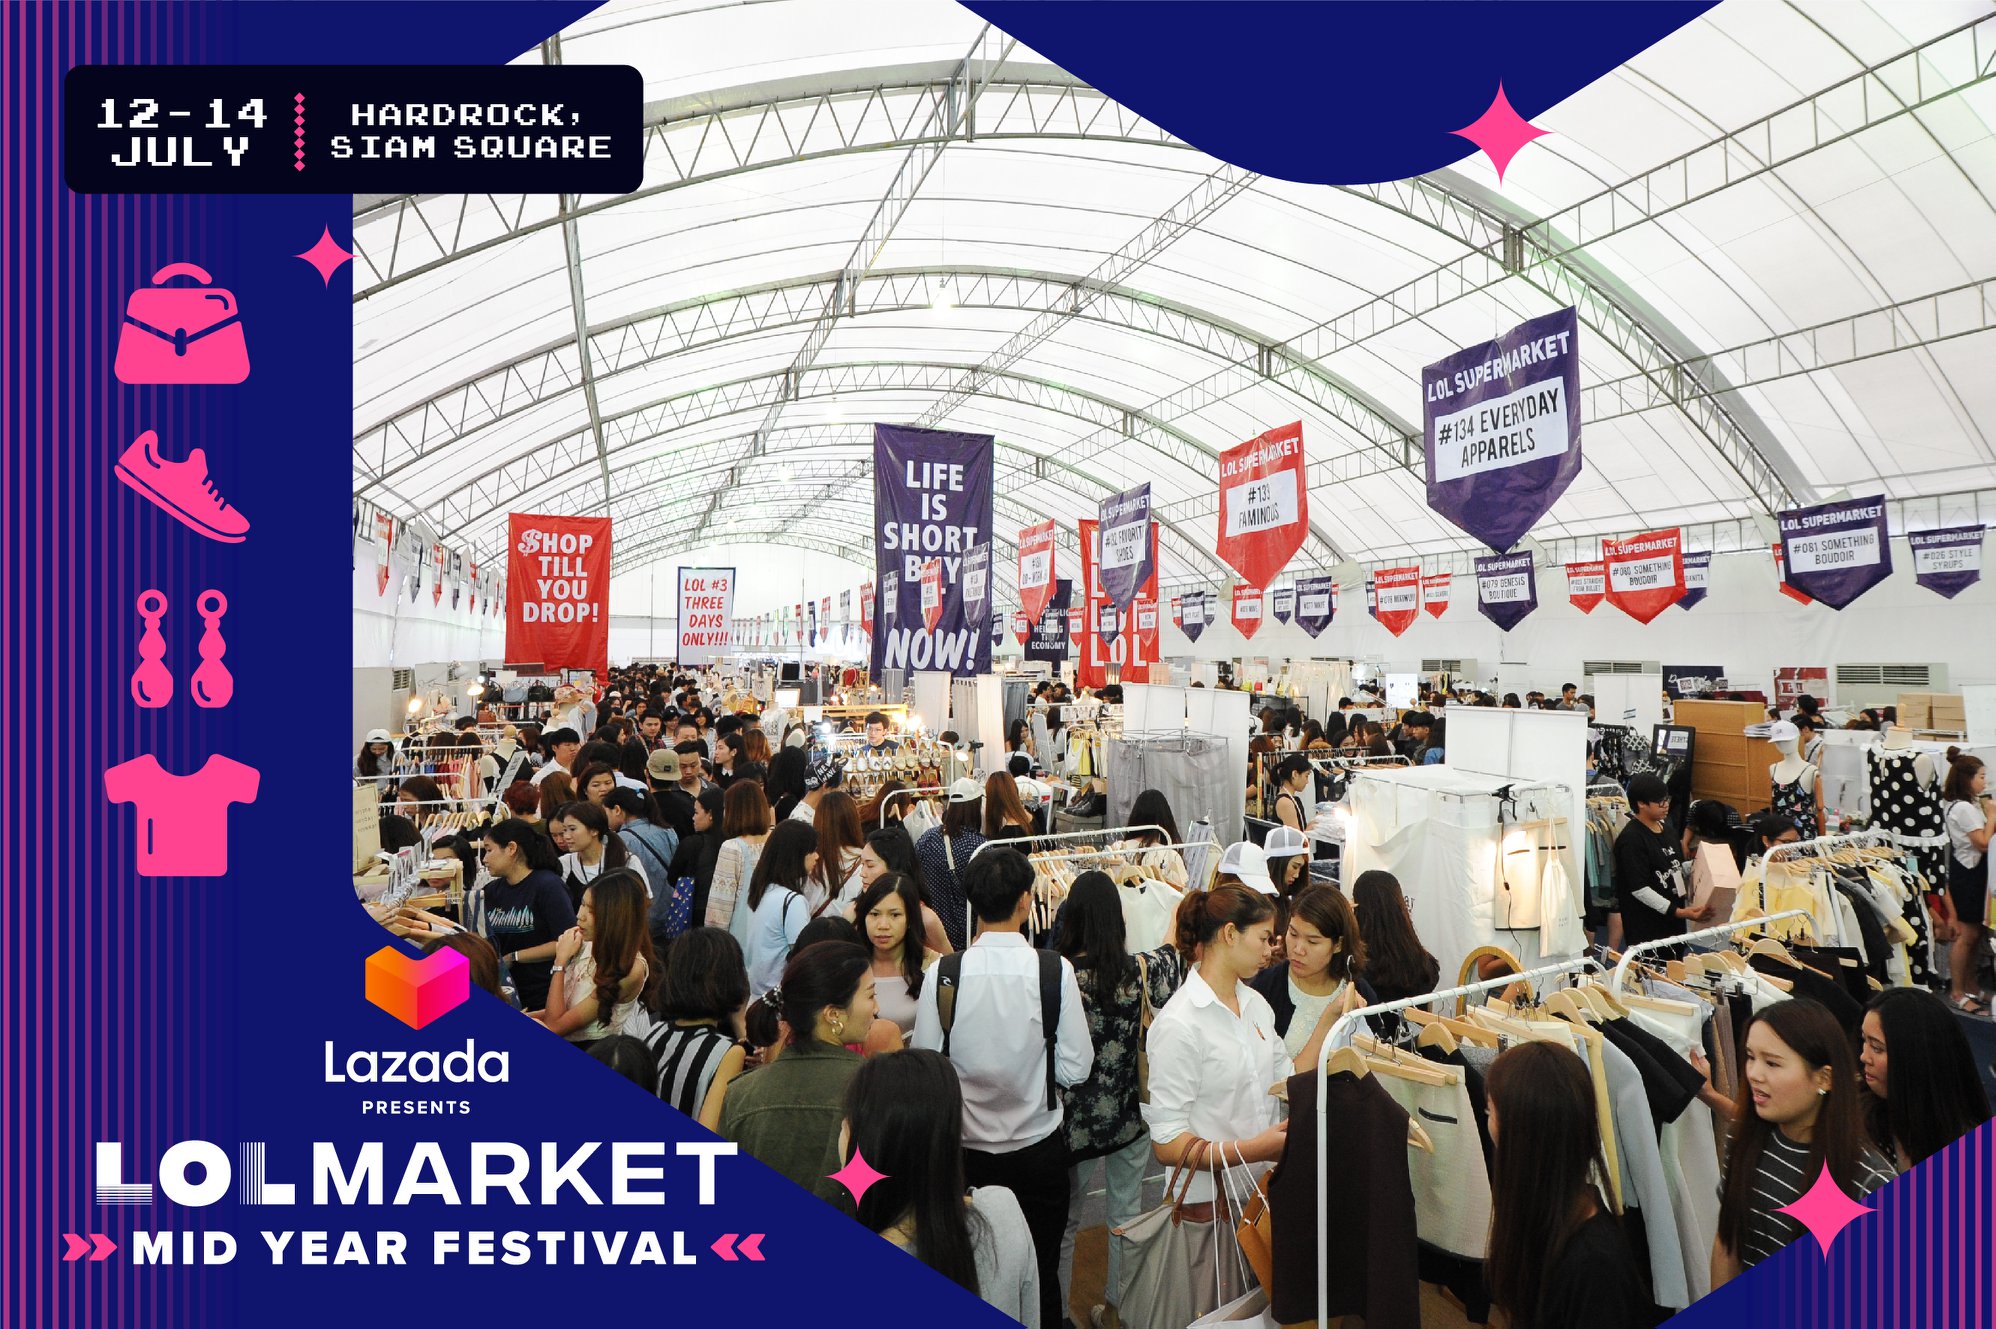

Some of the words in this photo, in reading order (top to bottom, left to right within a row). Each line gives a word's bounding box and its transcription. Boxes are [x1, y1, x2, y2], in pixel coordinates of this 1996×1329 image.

[1428, 380, 1454, 402] LOL
[1455, 331, 1570, 393] SUPERMARKET
[1439, 415, 1475, 445] #134
[1480, 387, 1559, 433] EVERYDAY
[1221, 462, 1237, 478] LOL
[1238, 437, 1299, 472] SUPERMARKET
[1461, 428, 1535, 468] APPARELS
[906, 461, 964, 491] LIFE
[921, 494, 947, 521] IS
[1238, 502, 1279, 528] FAMINOUS
[1781, 519, 1801, 531] LOL
[1802, 505, 1883, 528] SUPERMARKET
[884, 522, 978, 552] SHORT
[1618, 537, 1677, 555] SUPERMARKET
[1793, 541, 1819, 554] #081
[1821, 533, 1875, 551] SOMETHING
[1910, 536, 1924, 546] LOL
[1925, 531, 1984, 544] SUPERMARKET
[1487, 557, 1531, 571] SUPERMARKET
[1815, 551, 1855, 565] BOUDOIR
[1949, 548, 1973, 559] STYLE
[538, 556, 588, 577] TILL
[1634, 561, 1671, 574] SOMETHING
[1932, 560, 1964, 570] SYRUPS
[537, 579, 587, 600] YOU
[684, 578, 706, 592] LOL
[711, 579, 728, 592] #3
[1500, 576, 1525, 588] GENESIS
[1629, 575, 1658, 586] BOUDOIR
[685, 596, 724, 610] THREE
[1489, 589, 1517, 600] BOUTIQUE
[523, 602, 599, 623] DROP!
[689, 614, 723, 628] DAYS
[682, 632, 729, 646] ONLY!!!
[885, 628, 980, 670] NOW!
[1090, 633, 1147, 667] LOL
